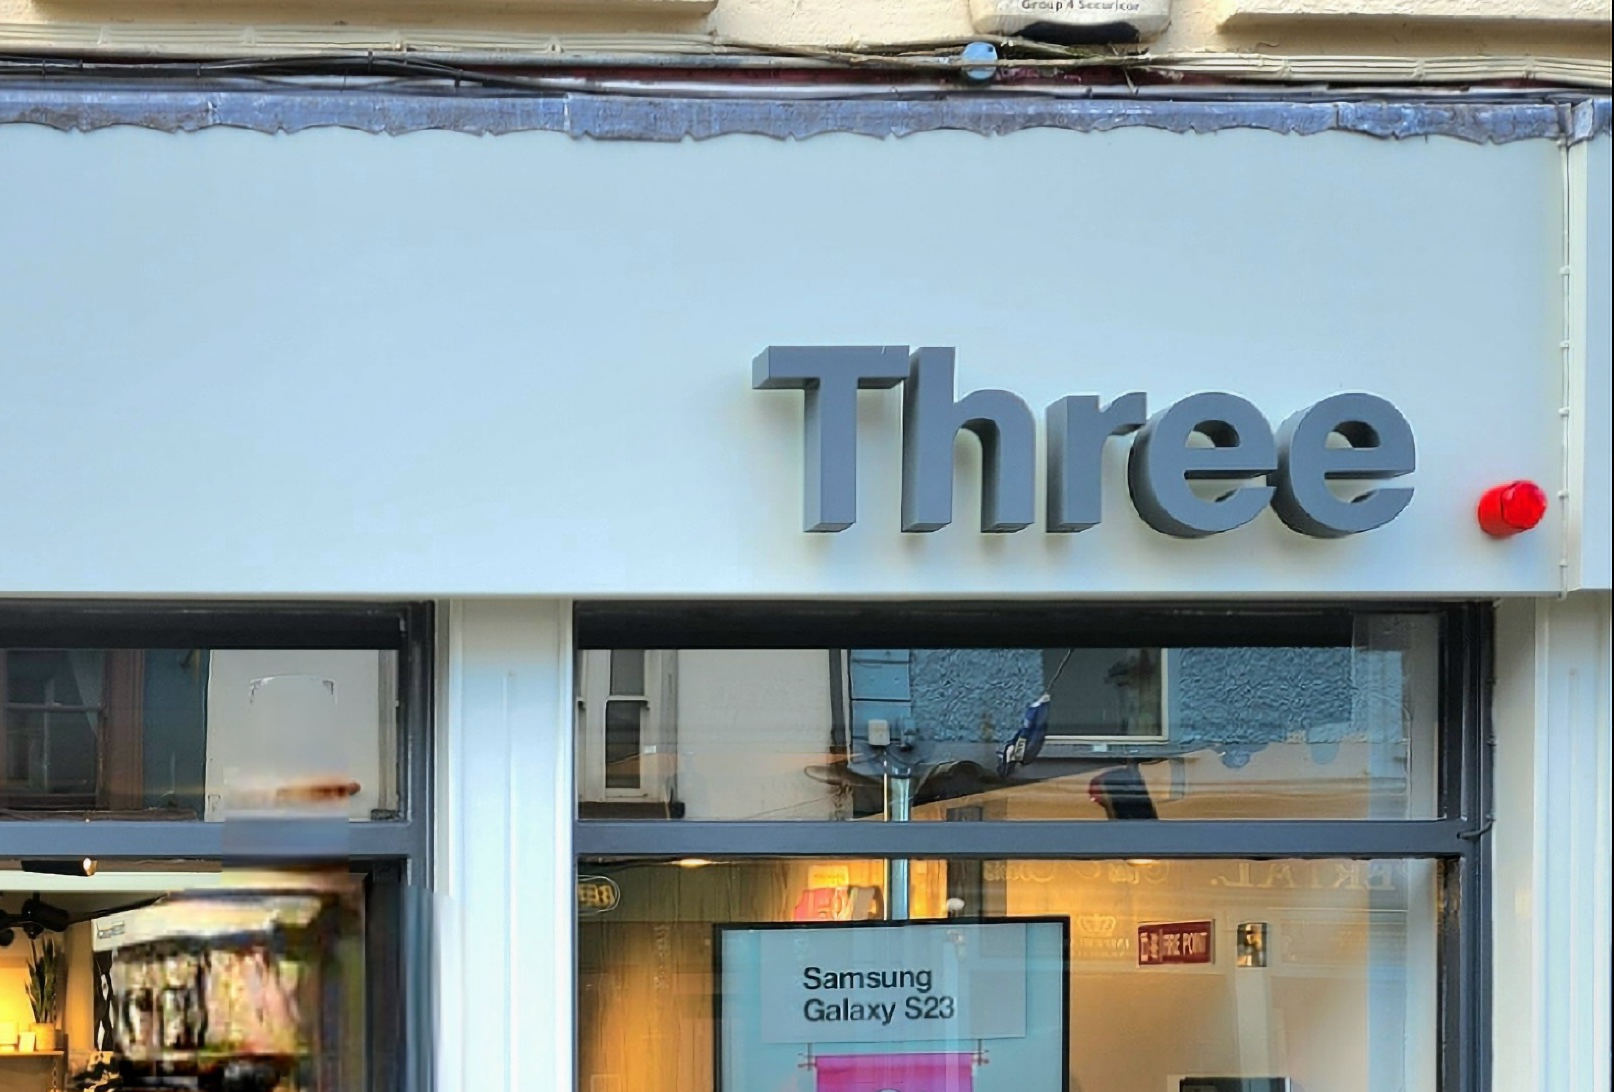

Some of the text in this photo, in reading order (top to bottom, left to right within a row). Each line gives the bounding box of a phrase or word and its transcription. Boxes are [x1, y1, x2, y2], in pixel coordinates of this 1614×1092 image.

[1021, 0, 1063, 11] Group
[752, 345, 1416, 539] Three
[802, 966, 933, 993] Samsung
[803, 996, 956, 1026] Galaxy S23
